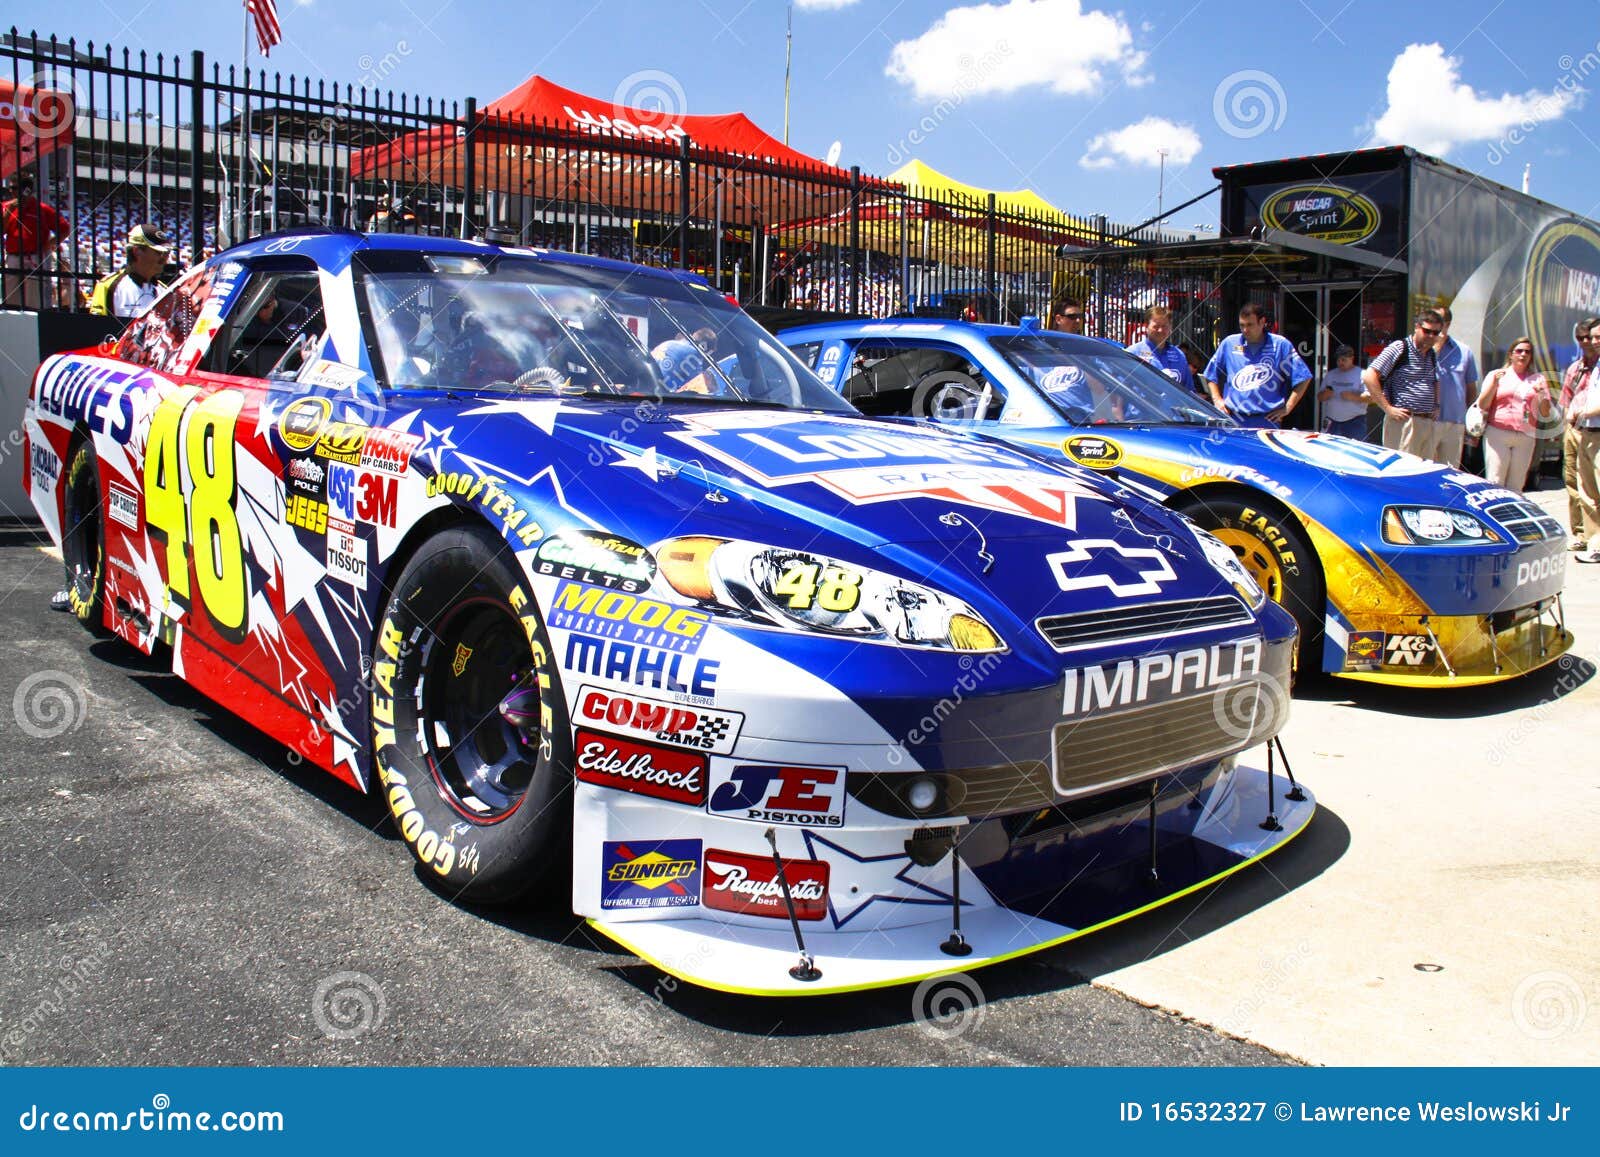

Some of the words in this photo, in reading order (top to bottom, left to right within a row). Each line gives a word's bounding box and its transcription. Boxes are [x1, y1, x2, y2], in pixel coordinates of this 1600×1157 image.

[1293, 197, 1332, 212] NASCAR
[1300, 211, 1338, 229] Sprint
[361, 456, 371, 466] HP
[372, 458, 399, 473] CARBS
[1081, 446, 1104, 457] Sprint
[143, 384, 246, 628] 48
[294, 479, 319, 493] POLE
[328, 464, 356, 520] USG
[356, 472, 399, 529] 3M
[286, 494, 329, 535] JEGS
[426, 472, 545, 547] GOODYEAR
[327, 547, 367, 578] TISSOT
[539, 561, 639, 592] BELTS
[1517, 551, 1565, 586] DODGE
[774, 564, 866, 613] 48
[554, 582, 709, 639] MOOG
[555, 611, 625, 639] CHASSIS
[633, 631, 692, 653] PARTS
[564, 632, 721, 698] MAHLE
[1062, 637, 1263, 716] IMPALA
[581, 691, 698, 736] COMP
[371, 616, 457, 877] GOODYEAR
[655, 729, 717, 750] CAMS
[578, 742, 702, 793] Edelbrock
[709, 764, 839, 813] JE
[747, 808, 842, 826] PISTONS
[610, 860, 694, 882] SUNOCO
[603, 898, 633, 907] OFFICIAL
[634, 897, 652, 906] FUEL
